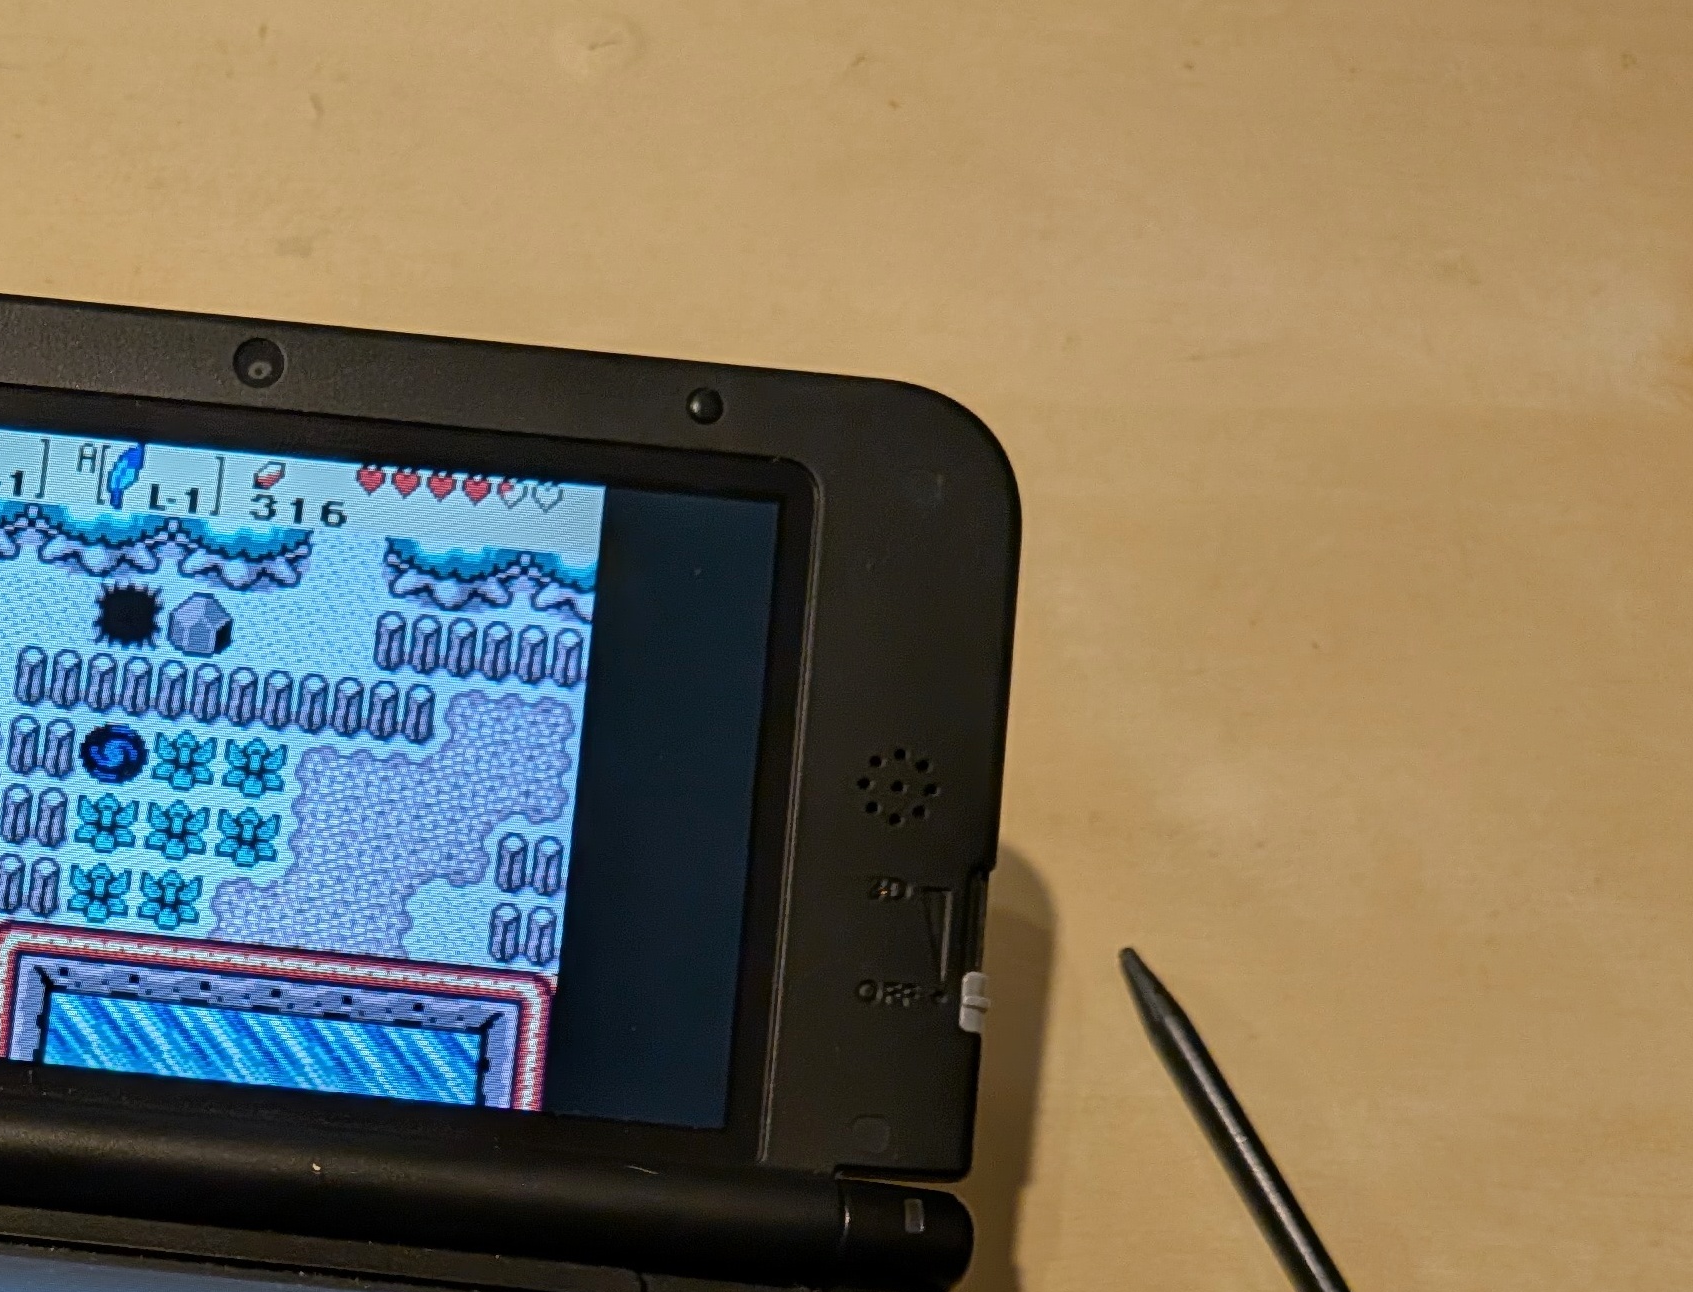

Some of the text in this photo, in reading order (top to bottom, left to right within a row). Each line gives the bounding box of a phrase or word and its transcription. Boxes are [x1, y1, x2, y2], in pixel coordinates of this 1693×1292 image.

[76, 443, 97, 473] A
[149, 484, 199, 514] L-1
[250, 494, 348, 527] 316
